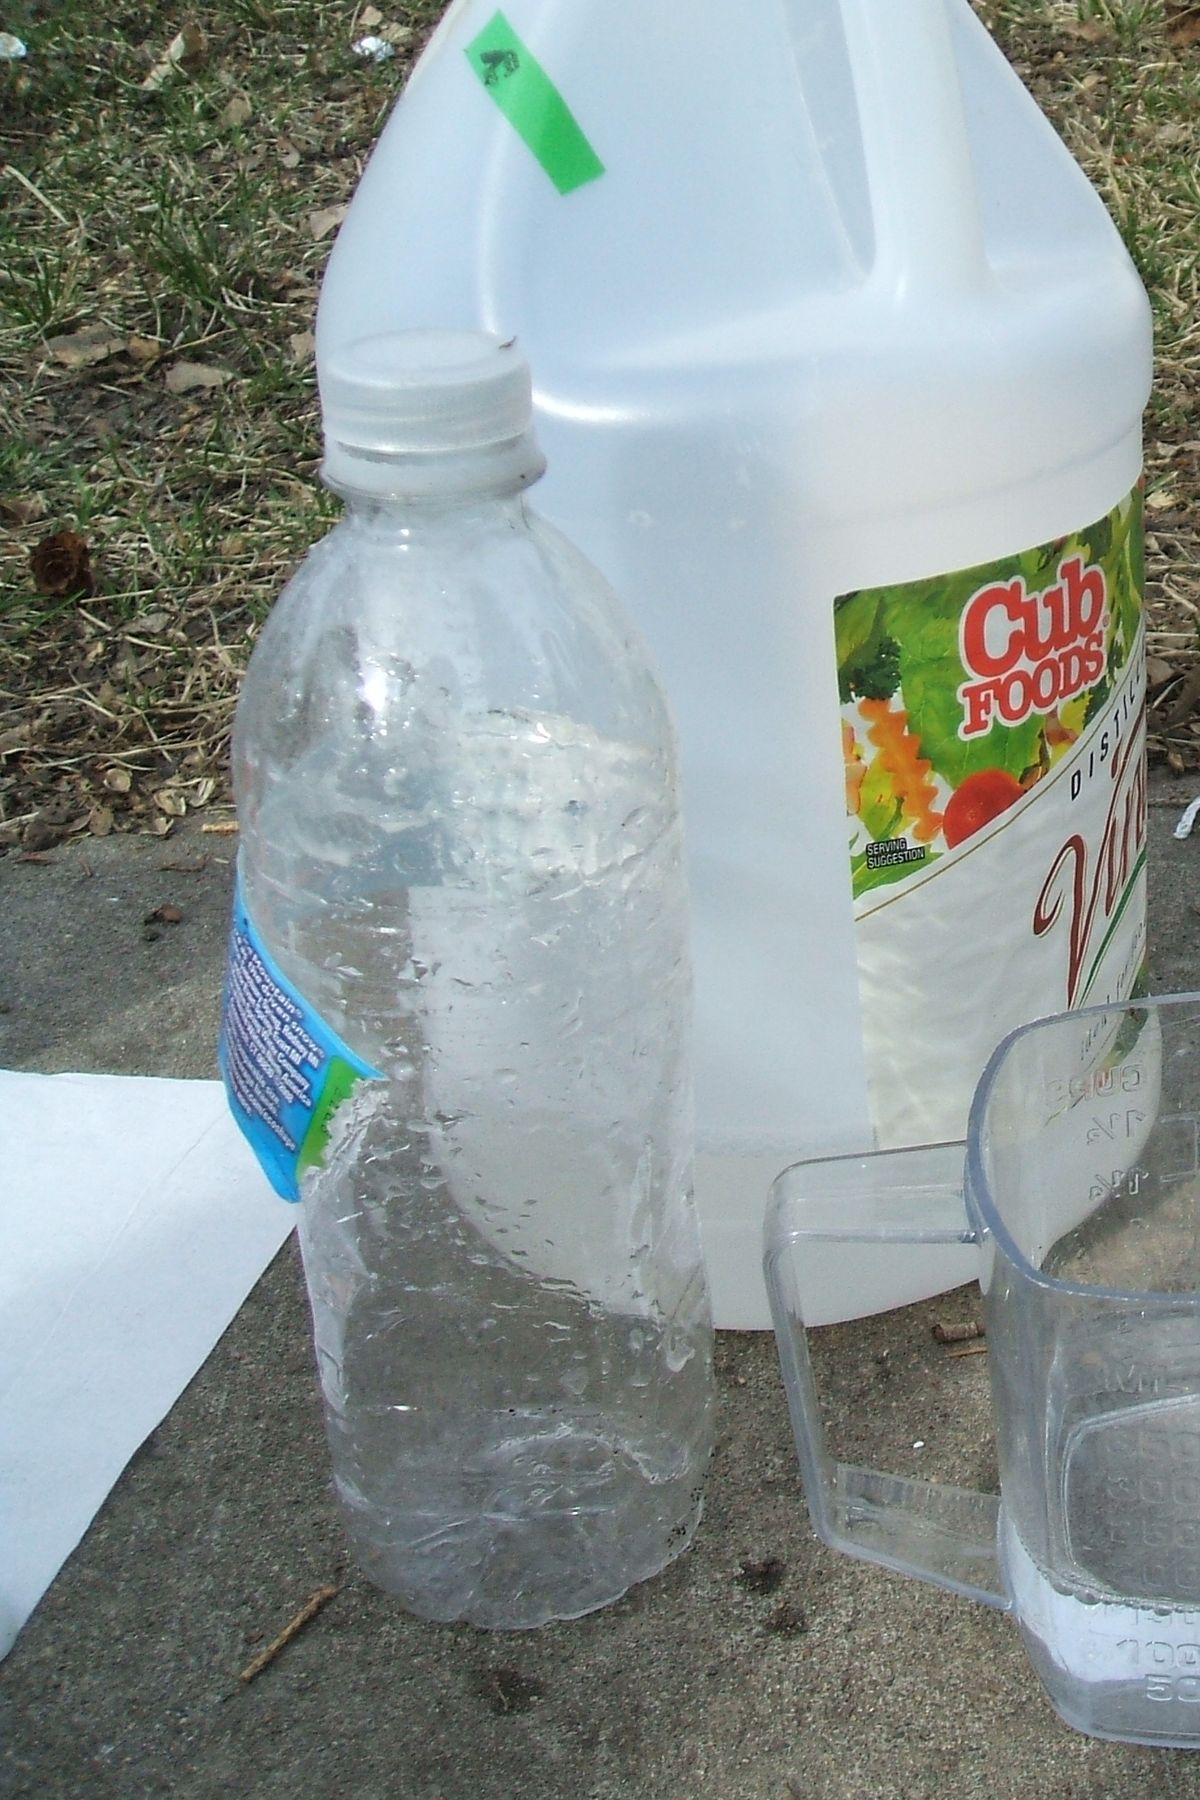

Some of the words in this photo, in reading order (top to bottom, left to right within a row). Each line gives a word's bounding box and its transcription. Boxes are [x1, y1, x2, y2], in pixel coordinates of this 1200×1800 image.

[964, 558, 1105, 678] Cub
[962, 630, 1105, 735] FOODS
[867, 838, 907, 856] SERVING
[868, 847, 924, 869] SUGGESTION
[258, 983, 291, 1022] driven
